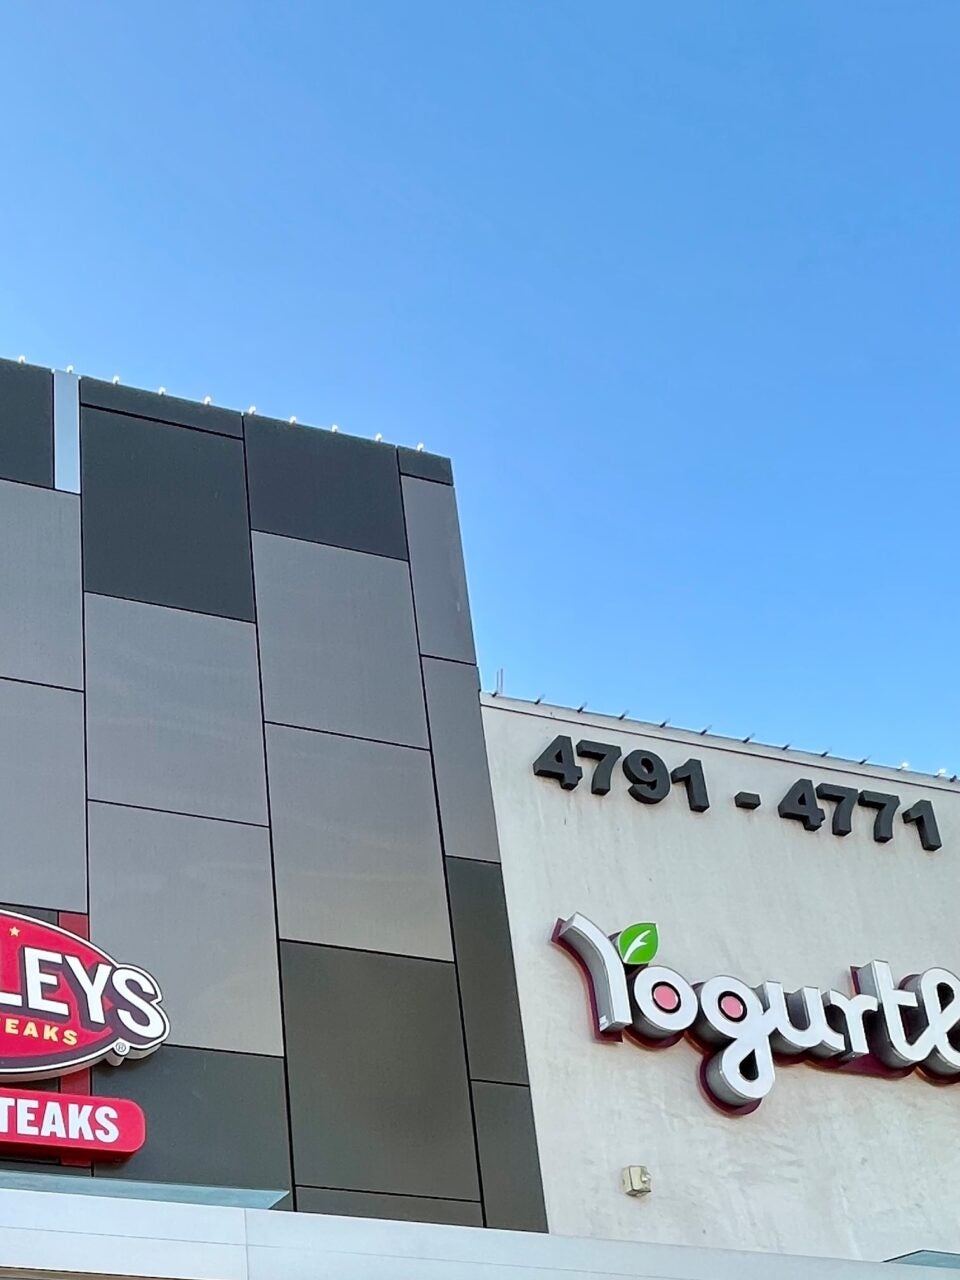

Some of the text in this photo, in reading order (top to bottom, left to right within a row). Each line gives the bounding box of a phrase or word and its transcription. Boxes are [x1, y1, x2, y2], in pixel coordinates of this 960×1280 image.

[533, 735, 942, 851] 4791 - 4771
